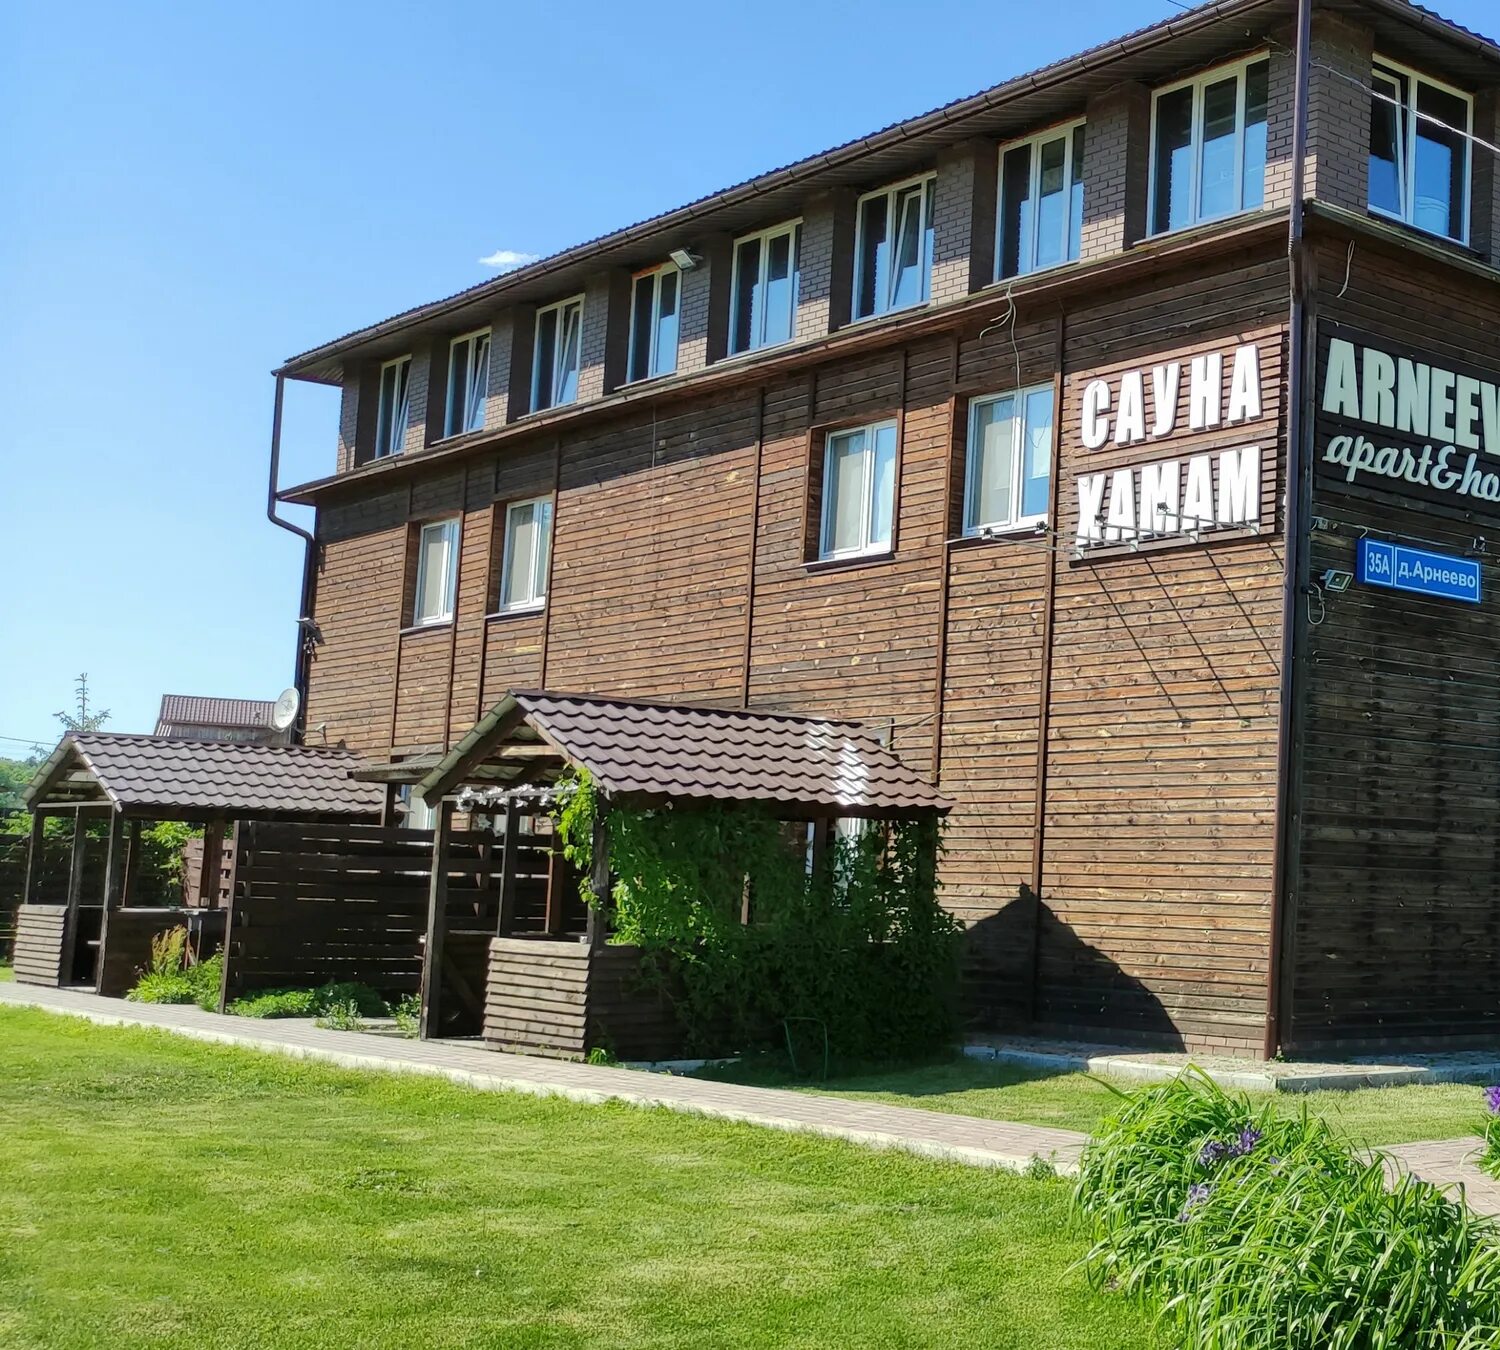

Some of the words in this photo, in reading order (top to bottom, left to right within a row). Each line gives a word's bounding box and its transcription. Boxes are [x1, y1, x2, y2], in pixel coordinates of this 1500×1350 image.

[1081, 344, 1262, 450] САУНА
[1075, 445, 1260, 547] ХАМАМ
[1398, 561, 1476, 588] д.Арнеево
